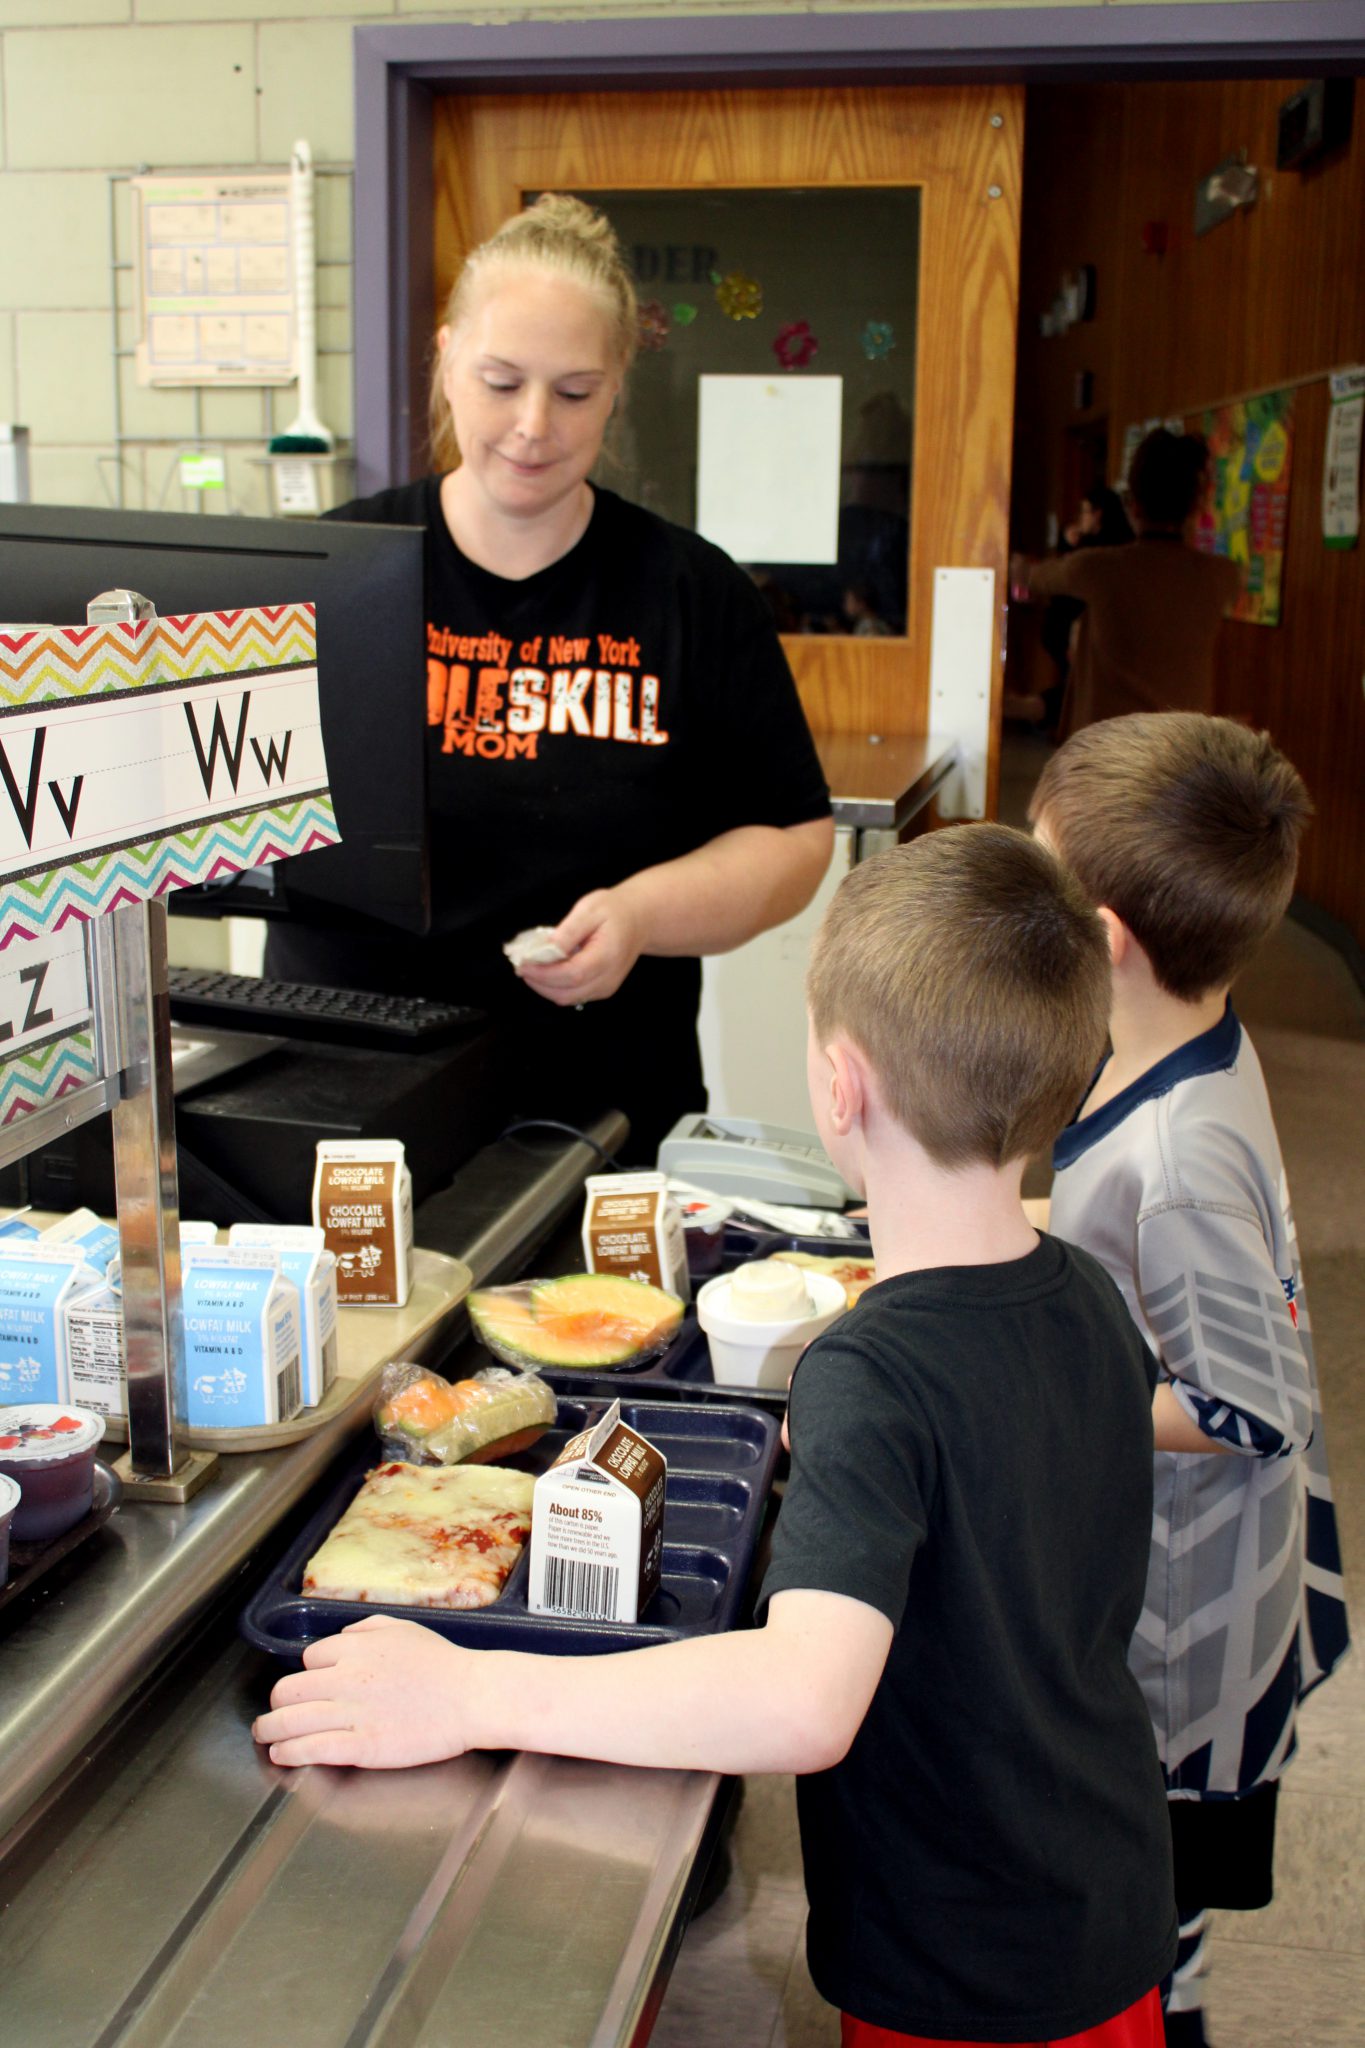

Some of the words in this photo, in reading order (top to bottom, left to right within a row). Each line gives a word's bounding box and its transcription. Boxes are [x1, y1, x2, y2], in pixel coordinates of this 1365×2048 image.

[633, 243, 719, 283] DER
[519, 636, 543, 664] of
[549, 636, 591, 666] New
[597, 633, 641, 668] York
[441, 730, 538, 760] MOM
[333, 1167, 384, 1177] CHOCOLATE
[328, 1176, 361, 1186] LOWFAT
[363, 1175, 385, 1185] MILK
[329, 1205, 383, 1217] CHOCOLATE
[327, 1217, 361, 1228] LOWFAT
[363, 1217, 386, 1228] MILK
[598, 1232, 648, 1246] CHOCOLATE
[194, 1279, 232, 1290] LOWFAT
[234, 1281, 260, 1292] MILK
[20, 1310, 45, 1324] MILK
[184, 1318, 224, 1331] LOWFAT
[226, 1319, 252, 1333] MILK
[194, 1345, 222, 1353] VITAMIN
[607, 1436, 635, 1469] CHOCOLATE
[562, 1484, 580, 1492] OPEN
[581, 1487, 602, 1495] OTHER
[549, 1502, 580, 1519] About
[581, 1508, 603, 1523] 85%
